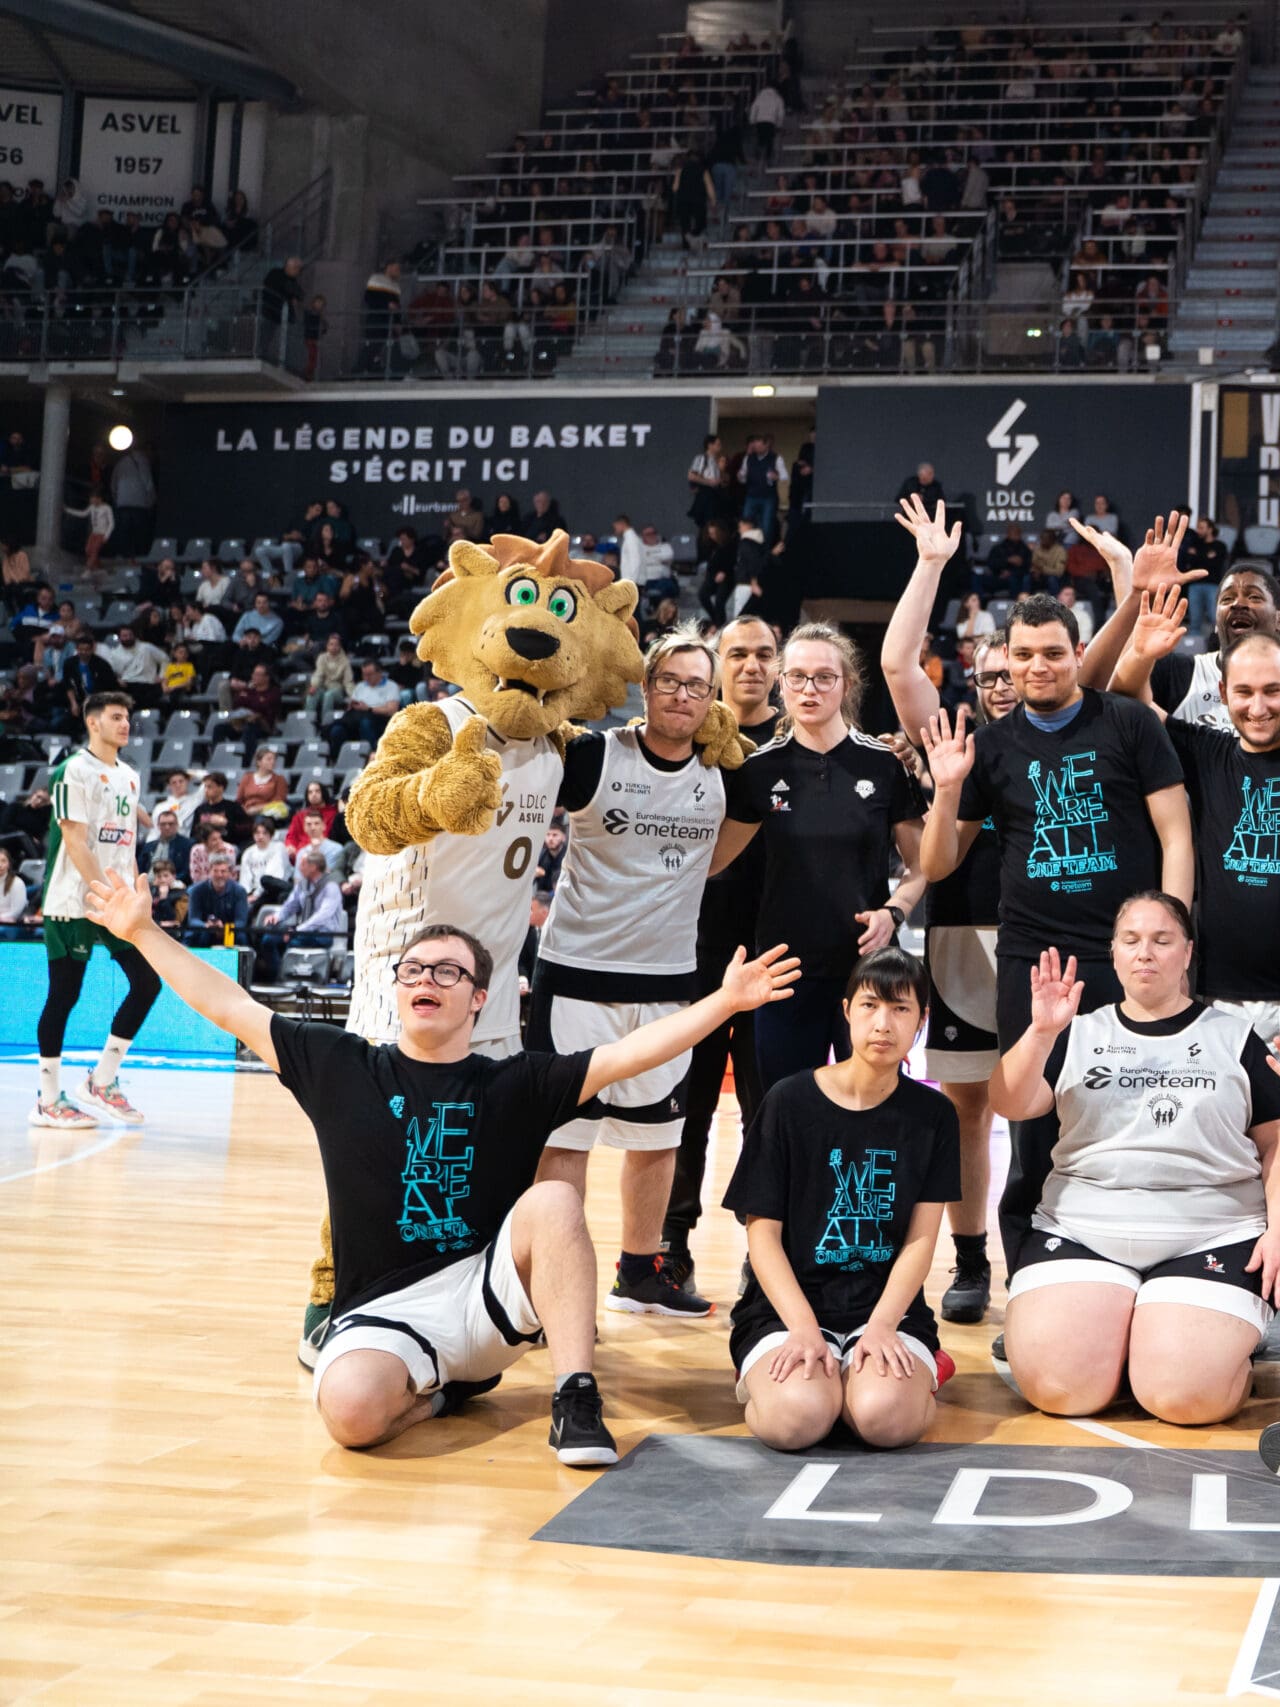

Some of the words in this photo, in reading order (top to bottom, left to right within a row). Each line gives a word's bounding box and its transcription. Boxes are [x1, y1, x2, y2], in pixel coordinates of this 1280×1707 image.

[100, 112, 181, 134] ASVEL
[114, 155, 163, 175] 1957
[97, 194, 175, 207] CHAMPION
[216, 429, 258, 451] LA
[273, 422, 434, 451] LÉGENDE
[449, 425, 495, 449] DU
[510, 423, 652, 448] BASKET
[329, 454, 467, 483] S'ÉCRIT
[482, 458, 530, 482] ICI
[986, 489, 1035, 507] LDLC
[986, 508, 1035, 522] ASVEL
[115, 793, 131, 817] 16
[519, 793, 548, 810] LDLC
[518, 811, 545, 824] ASVEL
[636, 812, 680, 823] Euroleague
[1034, 796, 1109, 832] ARE
[634, 822, 715, 841] oneteam
[1027, 820, 1116, 865] ALL
[503, 835, 533, 880] 0
[1026, 860, 1062, 879] ONE
[1062, 855, 1118, 876] TEAM
[1119, 1065, 1170, 1077] Euroleague
[1118, 1074, 1217, 1091] oneteam
[827, 1187, 894, 1221] ARE
[815, 1249, 850, 1265] ONE
